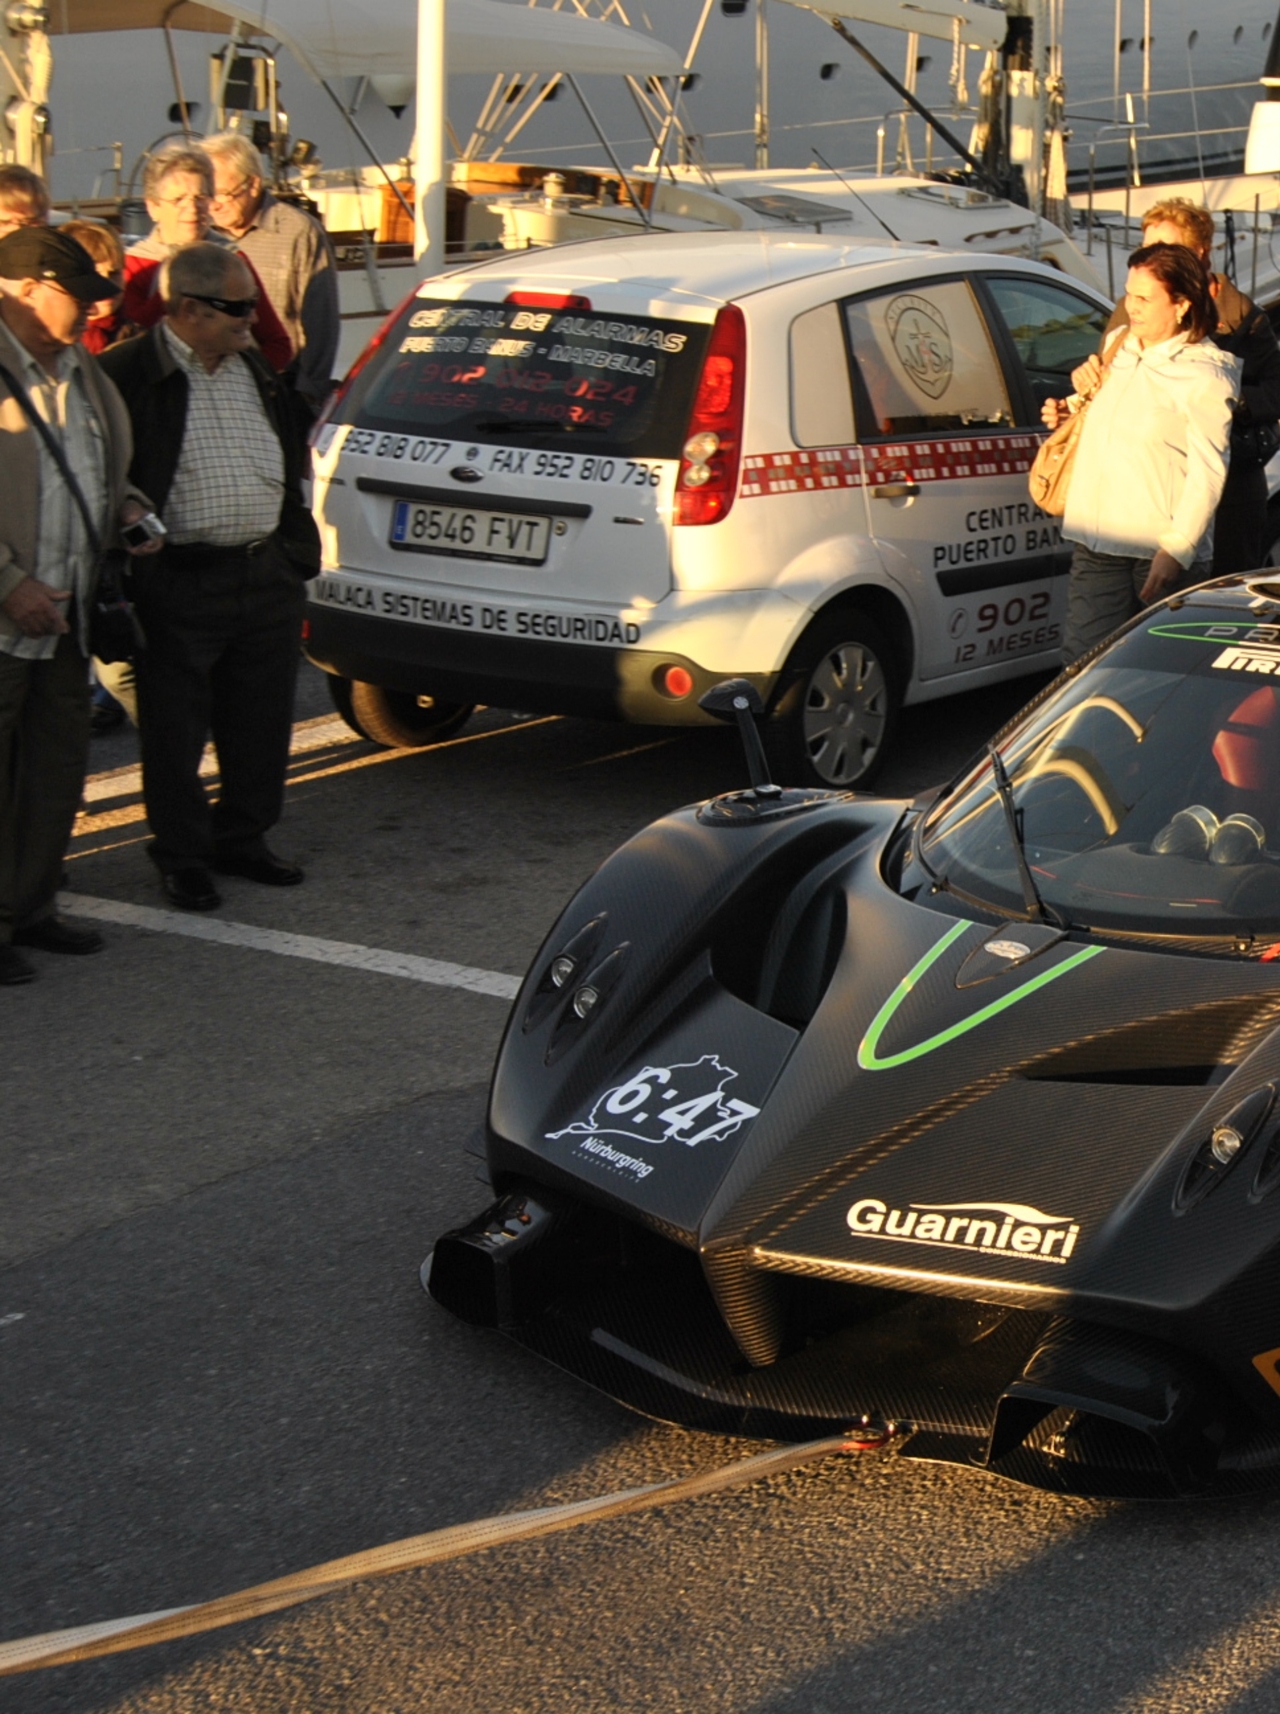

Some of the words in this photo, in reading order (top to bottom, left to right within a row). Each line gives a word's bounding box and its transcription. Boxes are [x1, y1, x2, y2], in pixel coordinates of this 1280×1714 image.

[409, 306, 506, 329] CENTRAL
[509, 311, 552, 332] DE
[552, 316, 688, 353] ALARMAS
[399, 336, 469, 353] PUERTO
[548, 344, 657, 377] MARBELLA
[563, 376, 639, 401] 024
[535, 402, 615, 427] HORAS
[376, 435, 414, 460] 818
[410, 440, 452, 465] 077
[488, 449, 531, 475] FAX
[533, 454, 575, 479] 952
[580, 458, 616, 483] 810
[620, 461, 663, 487] 736
[411, 509, 477, 545] 8546
[486, 516, 541, 552] FVT
[966, 503, 1054, 533] CENTRA
[933, 534, 1017, 568] PUERTO
[1026, 525, 1065, 551] BAN
[381, 591, 474, 628] SISTEMAS
[481, 607, 508, 631] DE
[515, 611, 642, 645] SEGURIDAD
[977, 591, 1051, 634] 902
[955, 643, 977, 664] 12
[986, 623, 1061, 656] MESES
[606, 1068, 761, 1147] 6:47
[580, 1137, 654, 1178] Nürburgring
[846, 1199, 1080, 1257] Guarnieri
